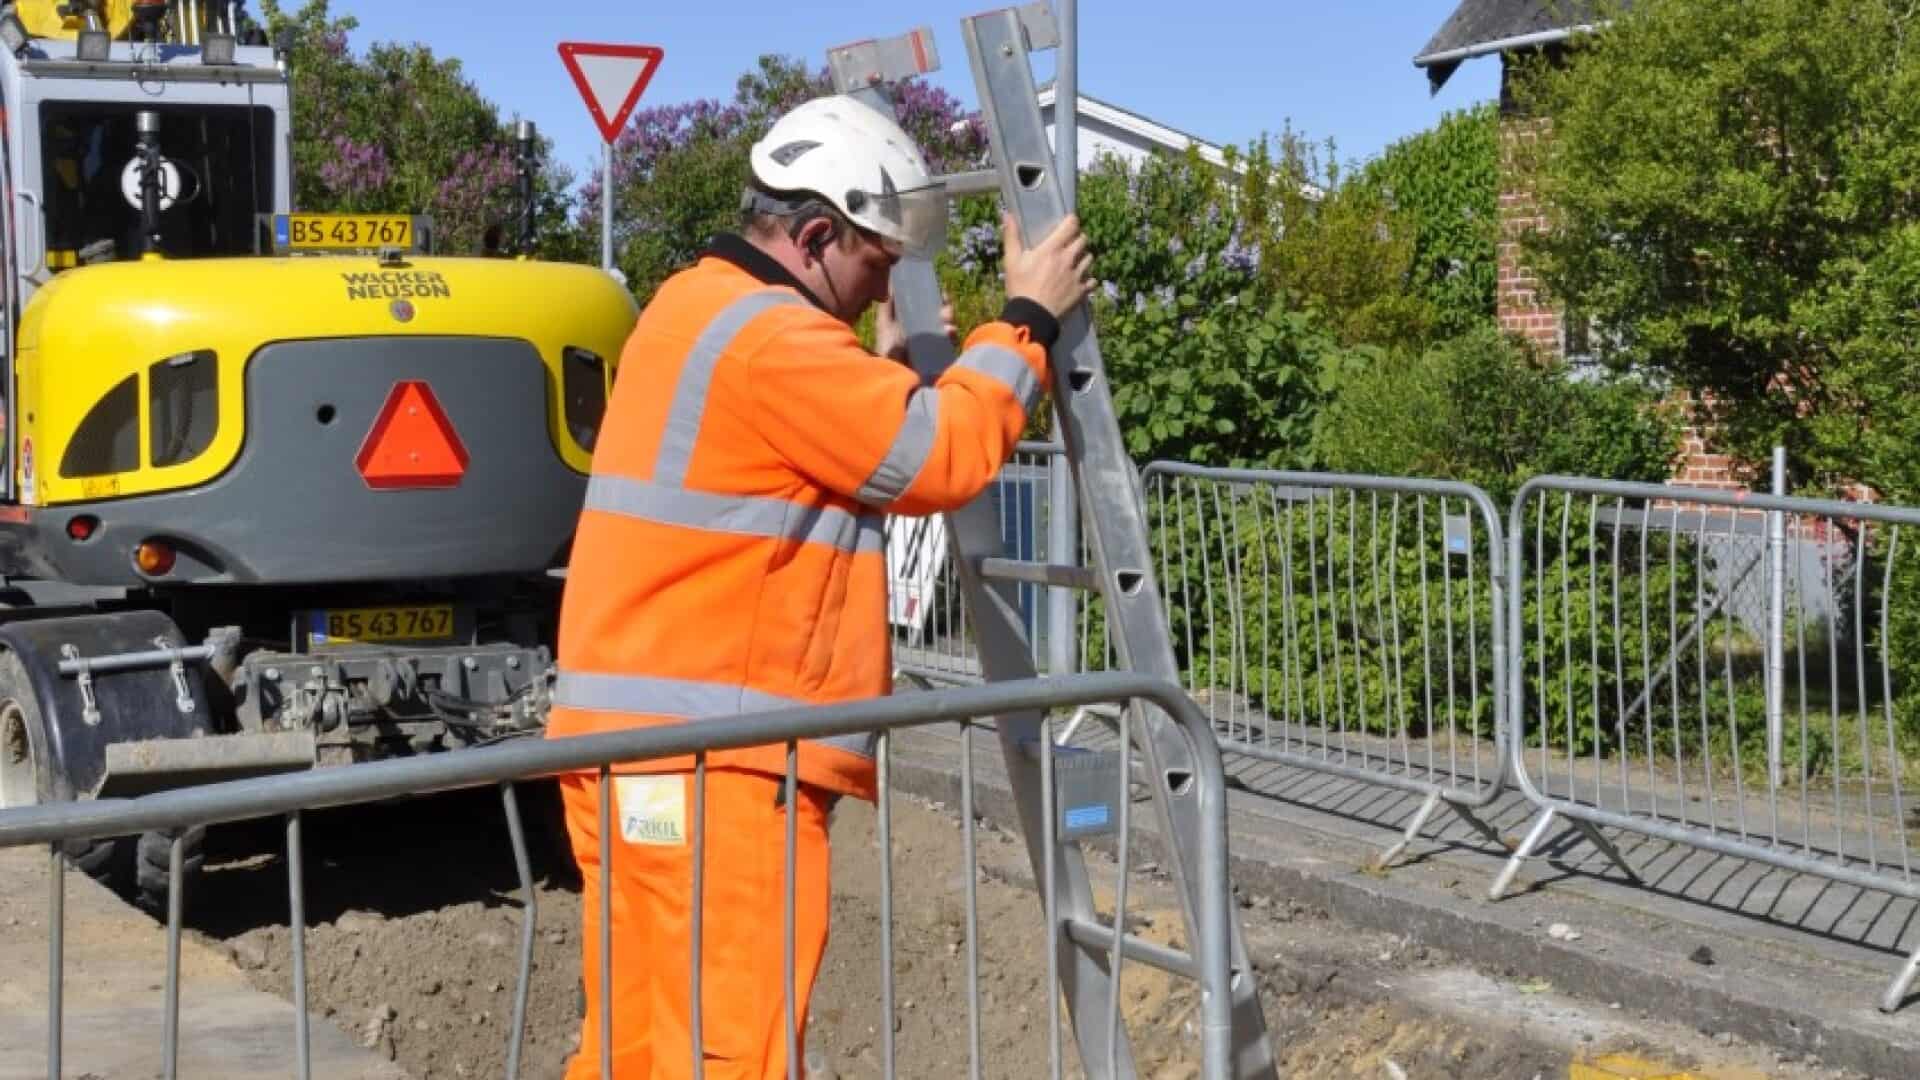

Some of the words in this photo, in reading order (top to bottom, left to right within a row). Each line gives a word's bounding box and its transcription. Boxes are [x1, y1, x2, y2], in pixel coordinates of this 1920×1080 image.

[292, 221, 324, 243] BS
[331, 221, 358, 242] 43
[366, 221, 408, 242] 767
[347, 284, 451, 299] NEUSON
[329, 614, 363, 638] BS
[369, 612, 398, 636] 43
[405, 609, 450, 634] 767
